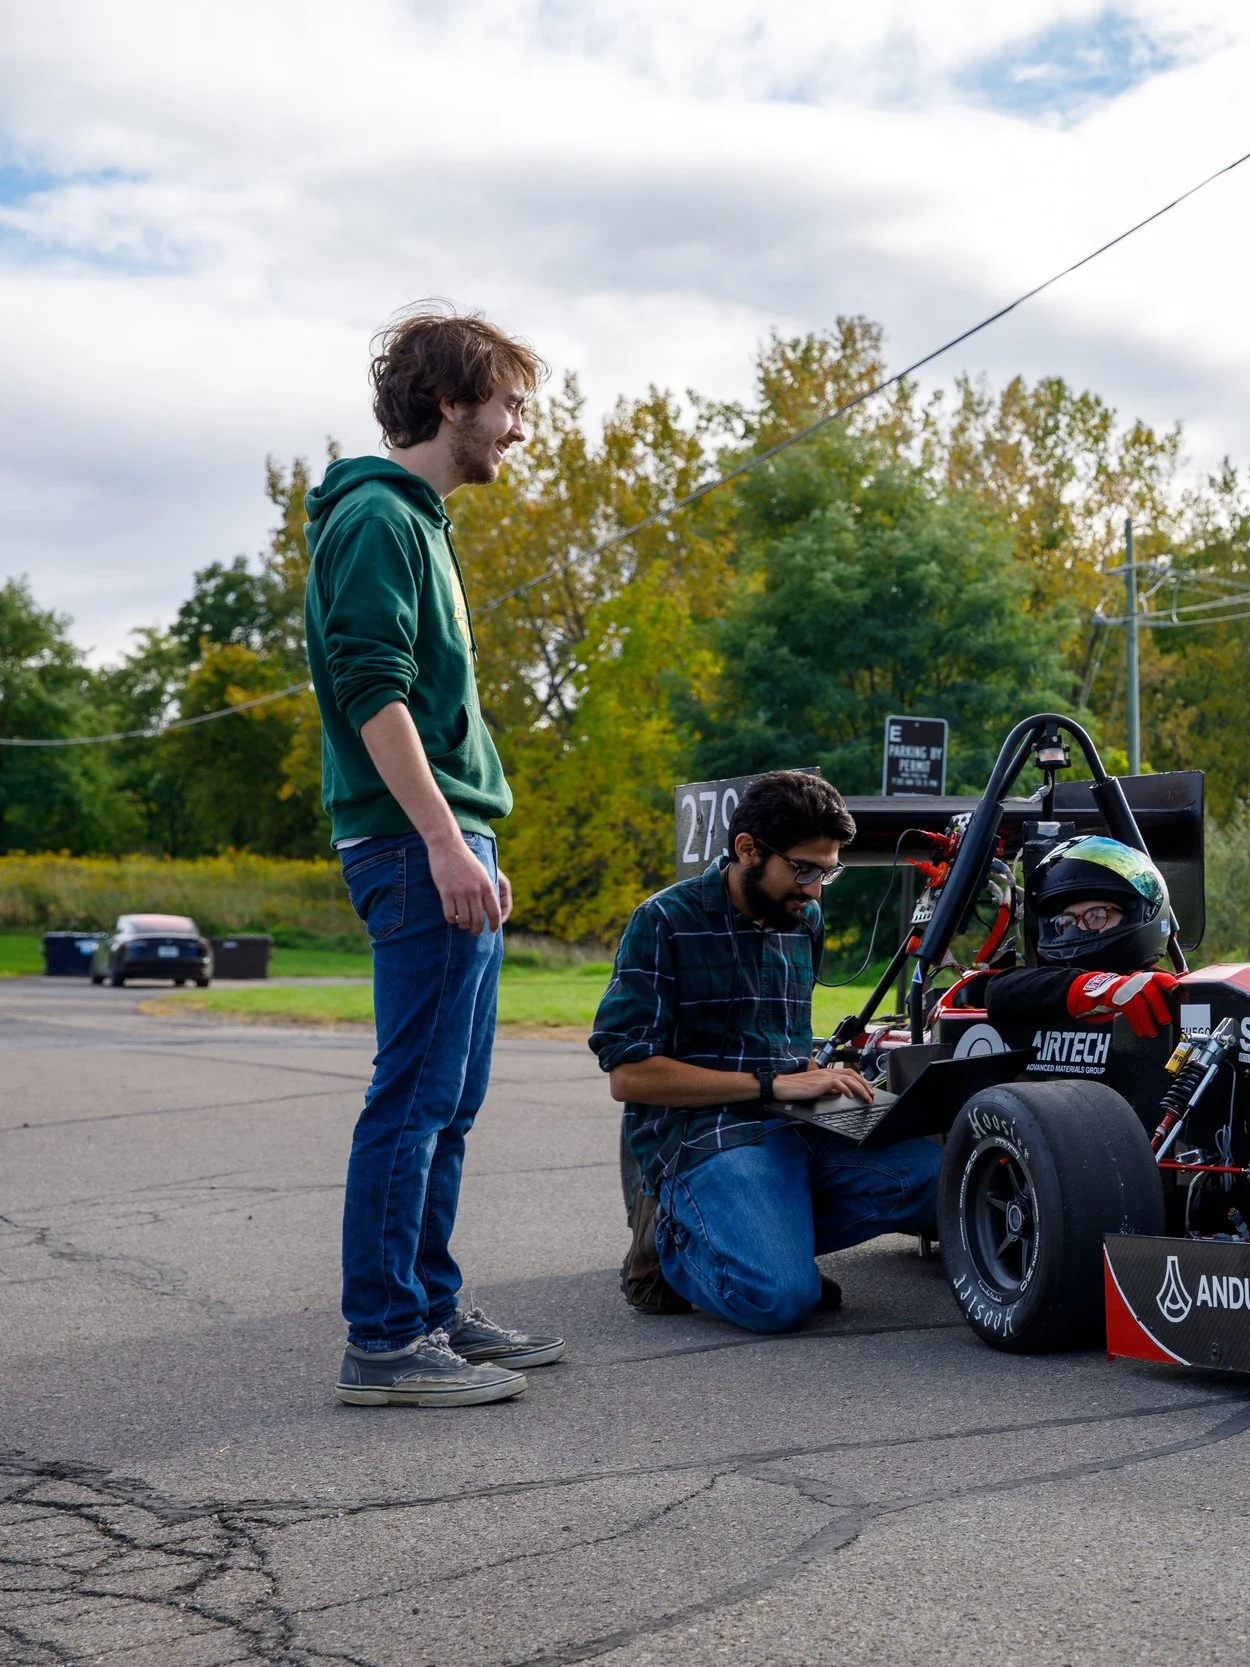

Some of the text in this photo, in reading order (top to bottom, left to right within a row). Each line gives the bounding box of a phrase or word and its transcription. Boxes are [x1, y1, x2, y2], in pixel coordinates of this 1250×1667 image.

[889, 725, 903, 743] E
[889, 744, 942, 760] PARKING BY
[898, 759, 931, 773] PERMIT
[1031, 1030, 1112, 1064] AIRTECH
[1026, 1063, 1106, 1075] ADVANCED MATERIALS GROUP
